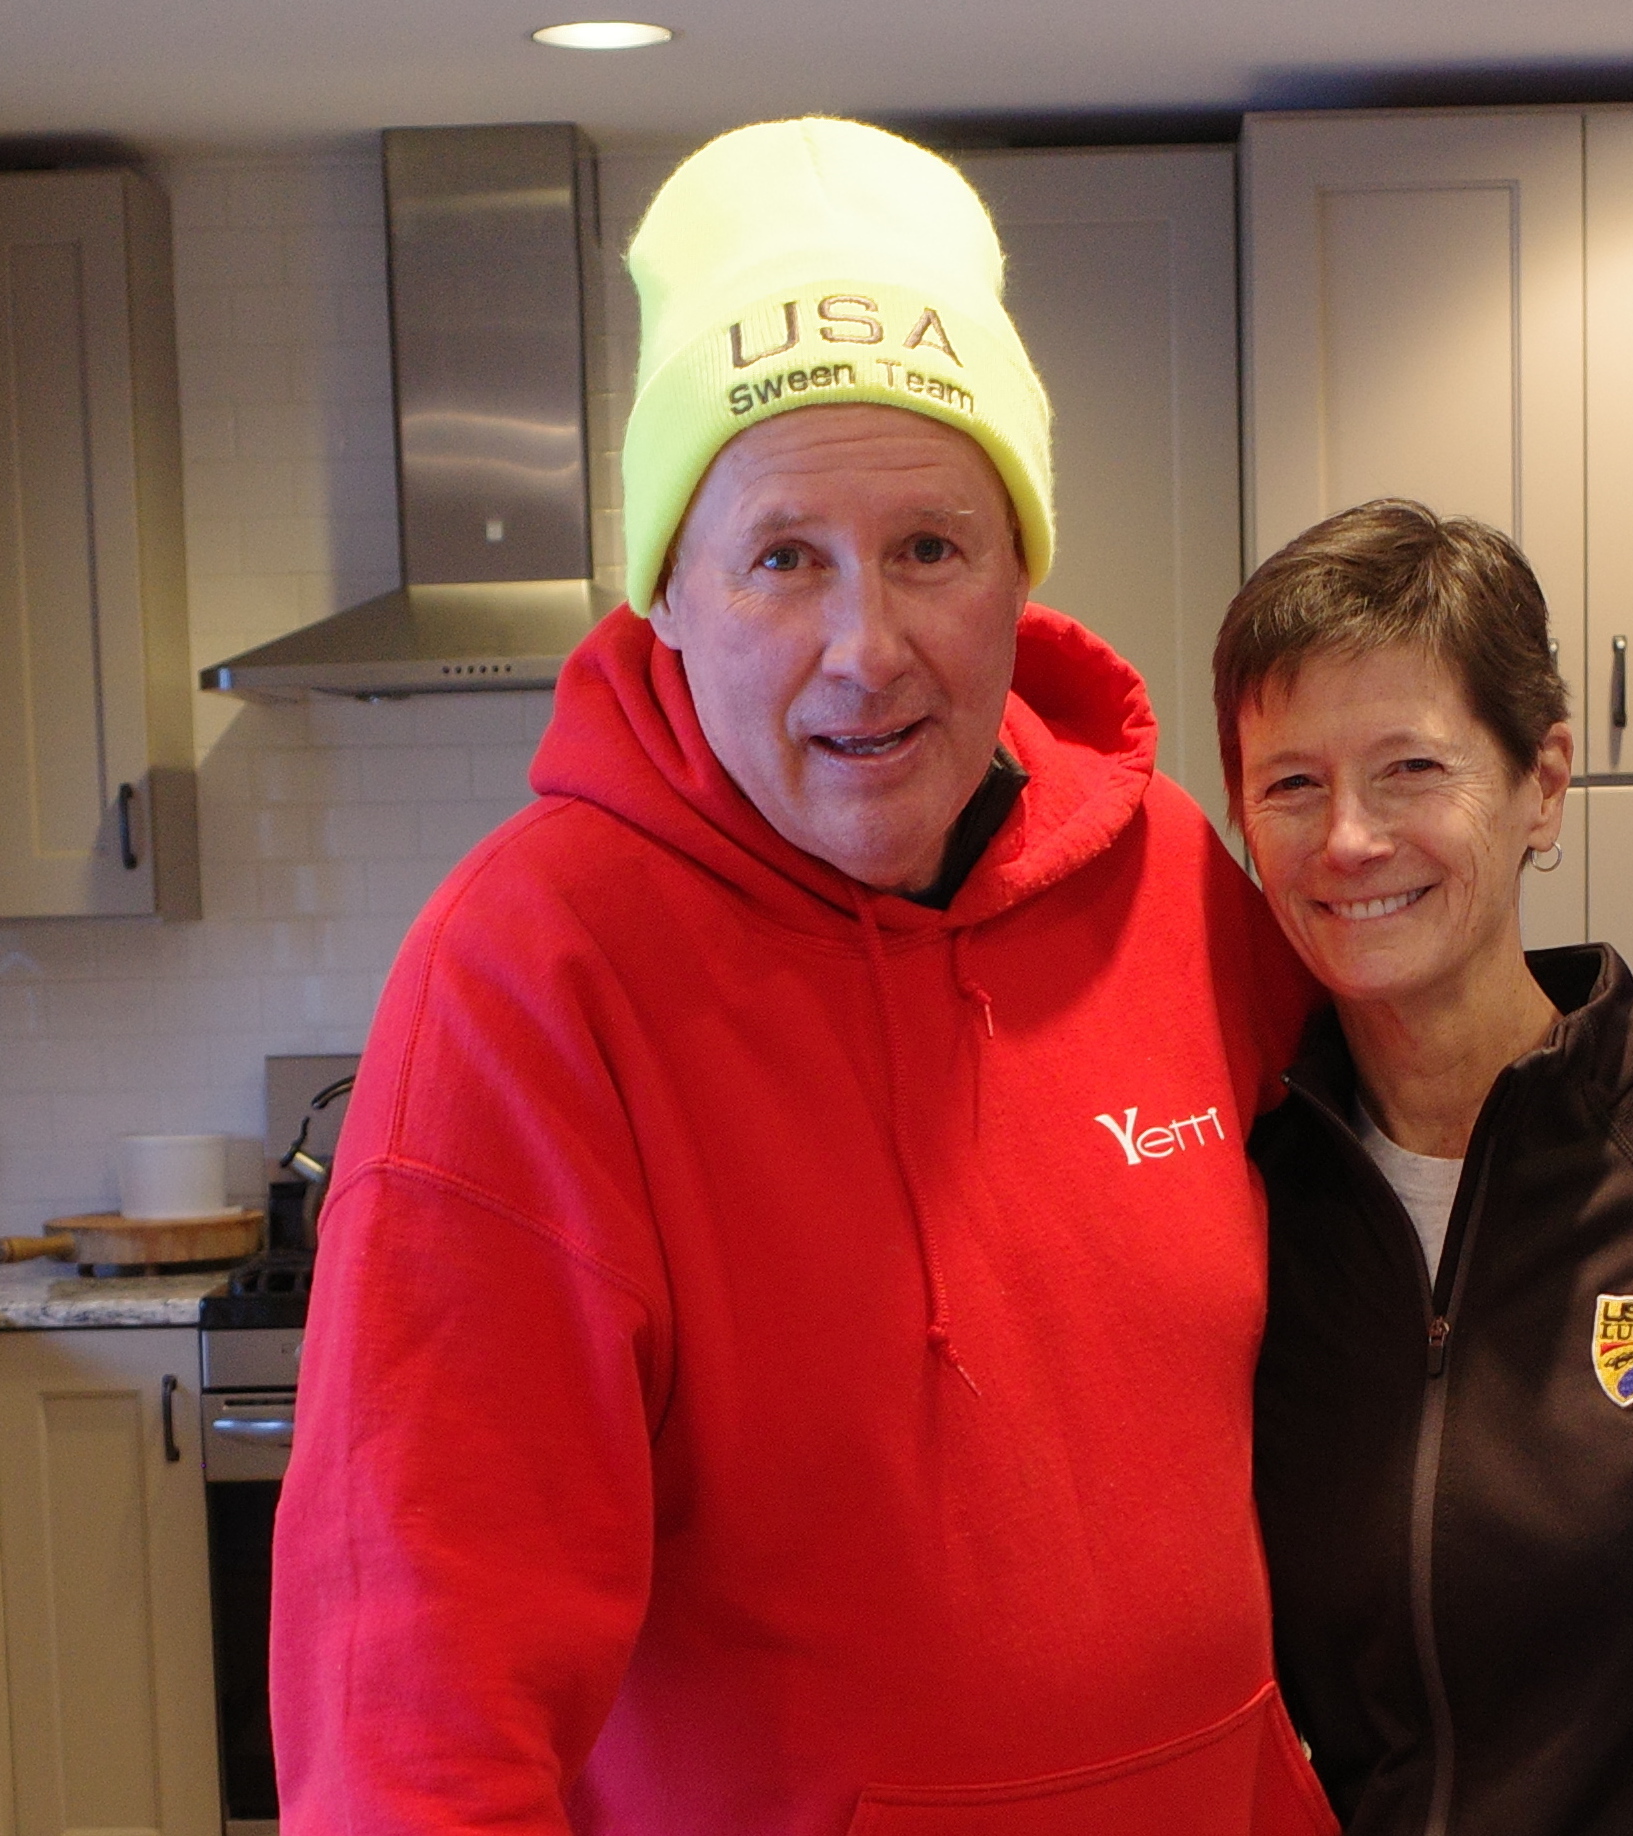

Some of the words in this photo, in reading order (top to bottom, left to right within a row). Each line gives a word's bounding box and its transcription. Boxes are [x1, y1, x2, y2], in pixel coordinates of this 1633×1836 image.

[728, 294, 964, 371] USA
[728, 362, 855, 416] Sween
[874, 356, 974, 413] Team
